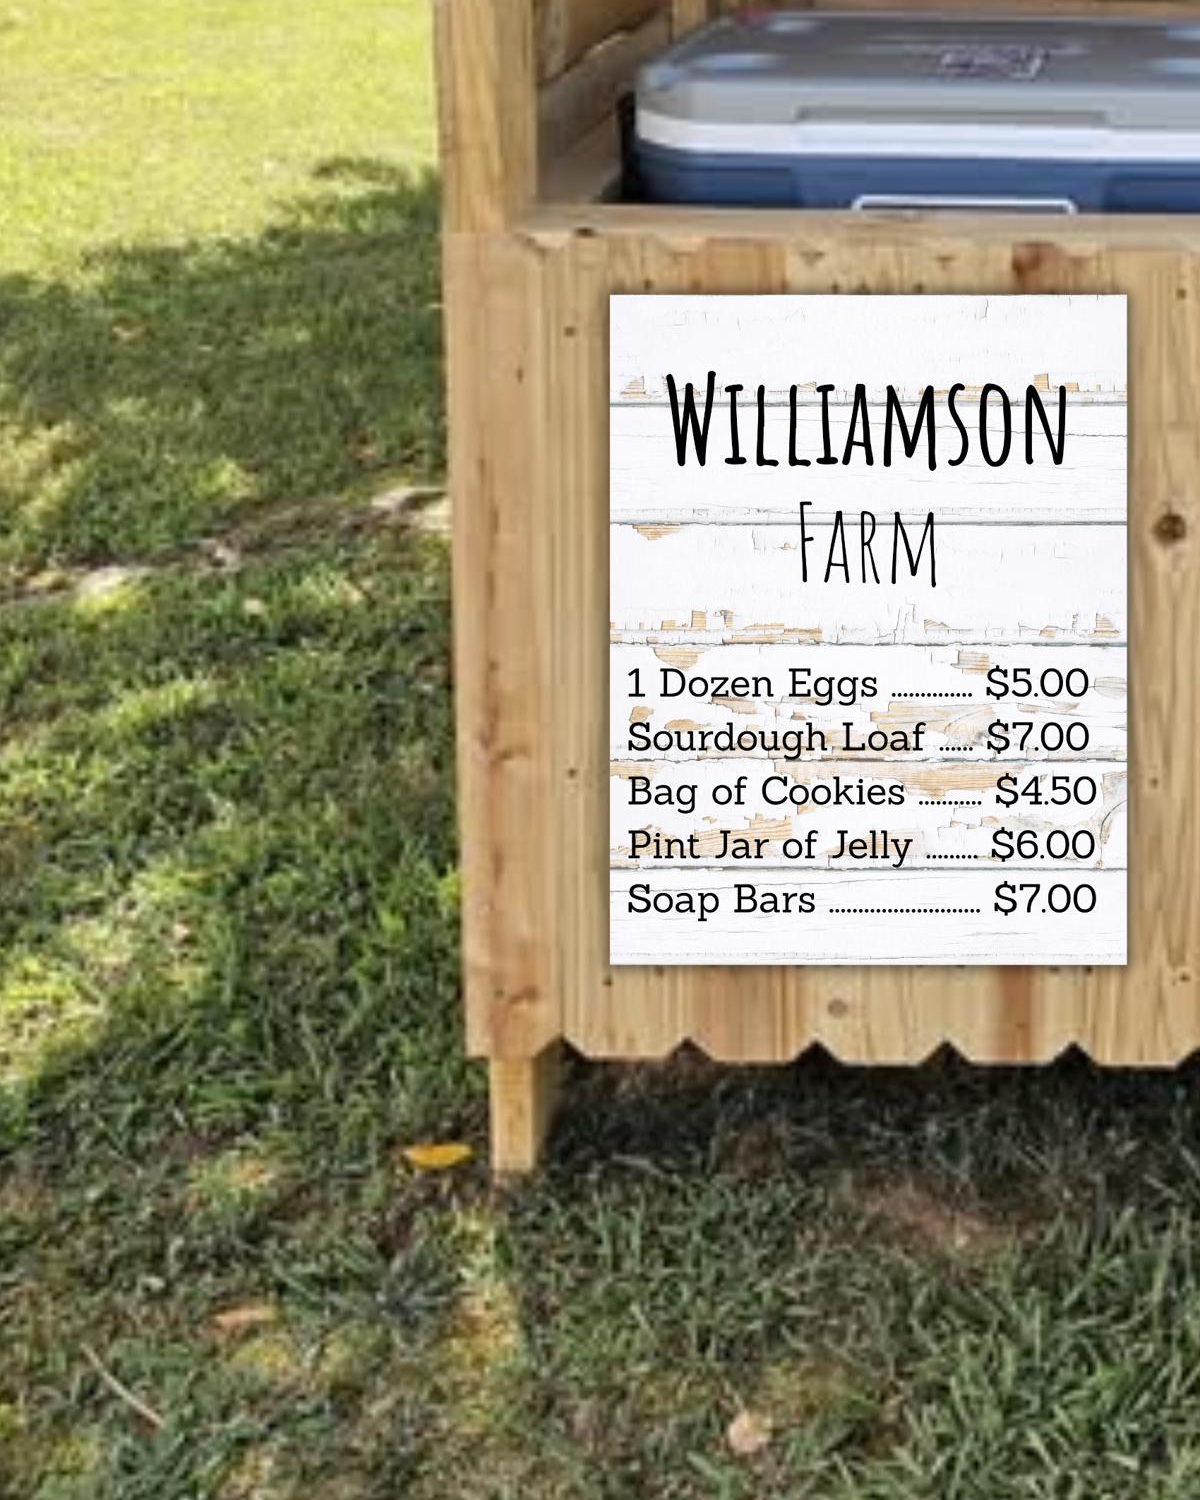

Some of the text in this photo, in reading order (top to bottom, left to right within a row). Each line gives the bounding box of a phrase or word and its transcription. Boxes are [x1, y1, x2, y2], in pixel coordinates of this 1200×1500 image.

[628, 664, 1089, 706] 1 Dozen Eggs $5.00
[628, 718, 1090, 758] Sourdough Loaf $7.00
[628, 772, 1097, 814] Bag of Cookies $4.50
[628, 826, 1095, 868] Pint Jar of Jelly $6.00
[628, 880, 1097, 922] Soap Bars $7.00
